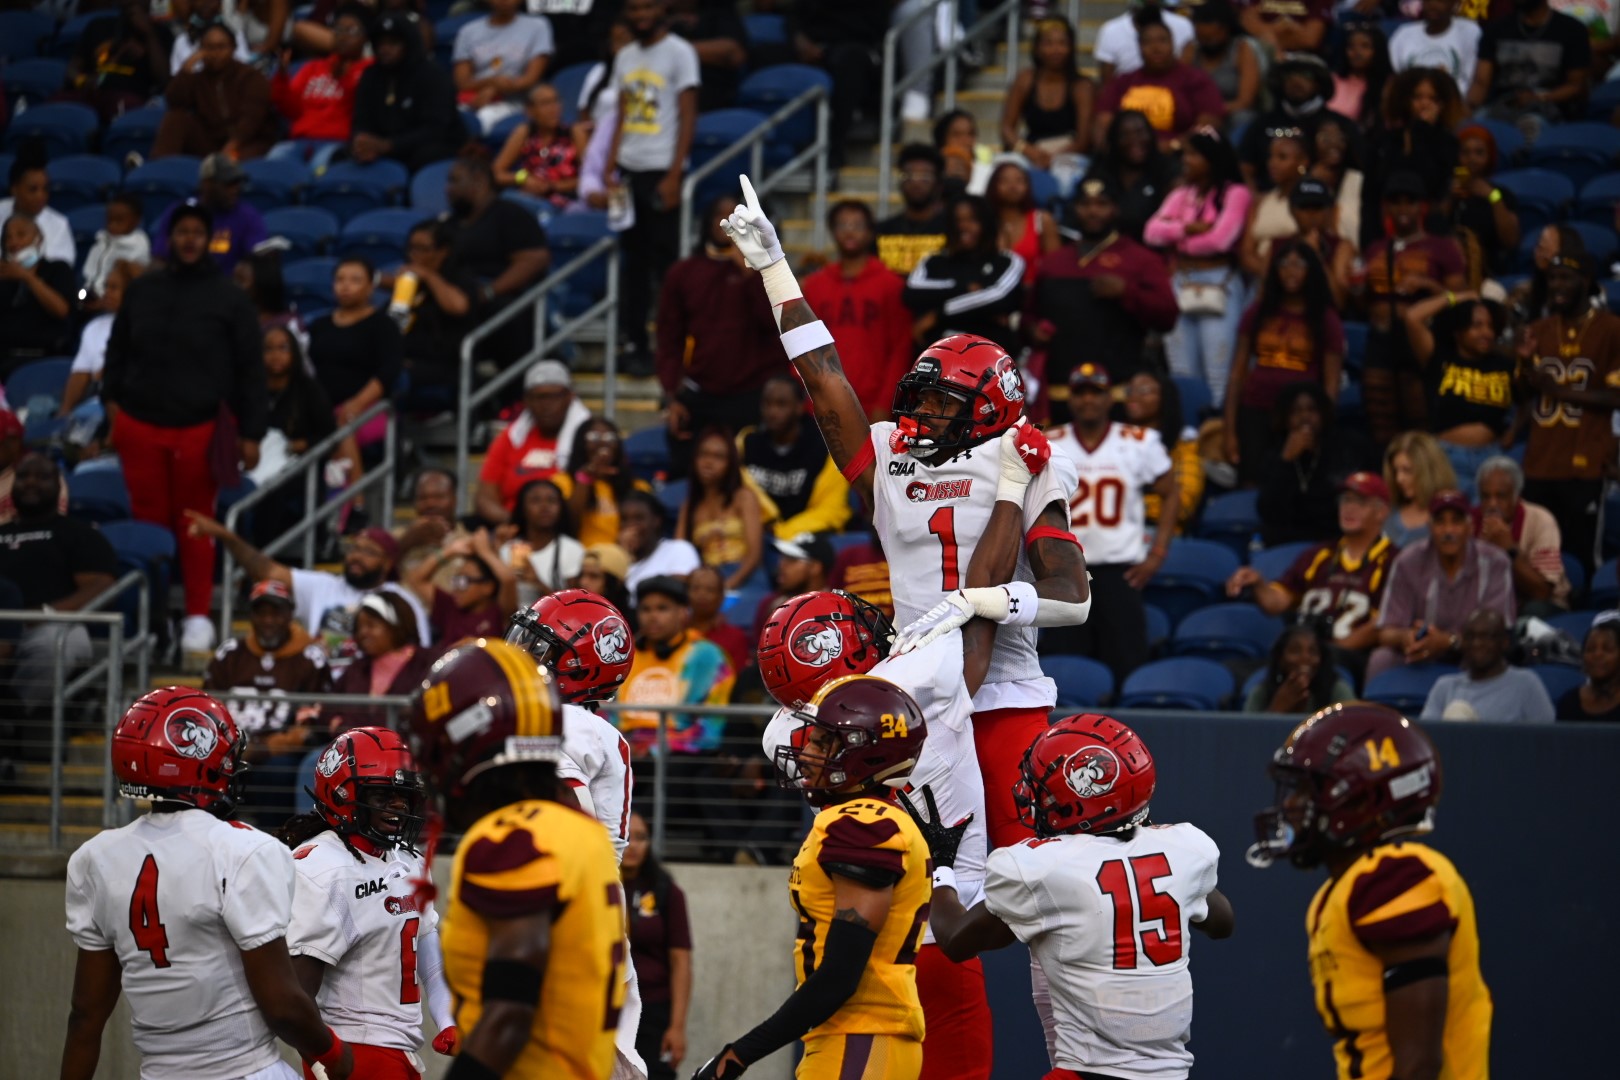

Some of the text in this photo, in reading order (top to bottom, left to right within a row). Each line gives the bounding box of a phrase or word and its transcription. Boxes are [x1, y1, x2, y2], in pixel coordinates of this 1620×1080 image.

[888, 461, 915, 476] CIAA
[928, 506, 959, 592] 1
[880, 713, 907, 738] 24
[131, 760, 137, 772] 4
[1365, 737, 1399, 771] 14
[838, 803, 887, 816] 24
[129, 853, 171, 968] 4
[1096, 852, 1182, 969] 15
